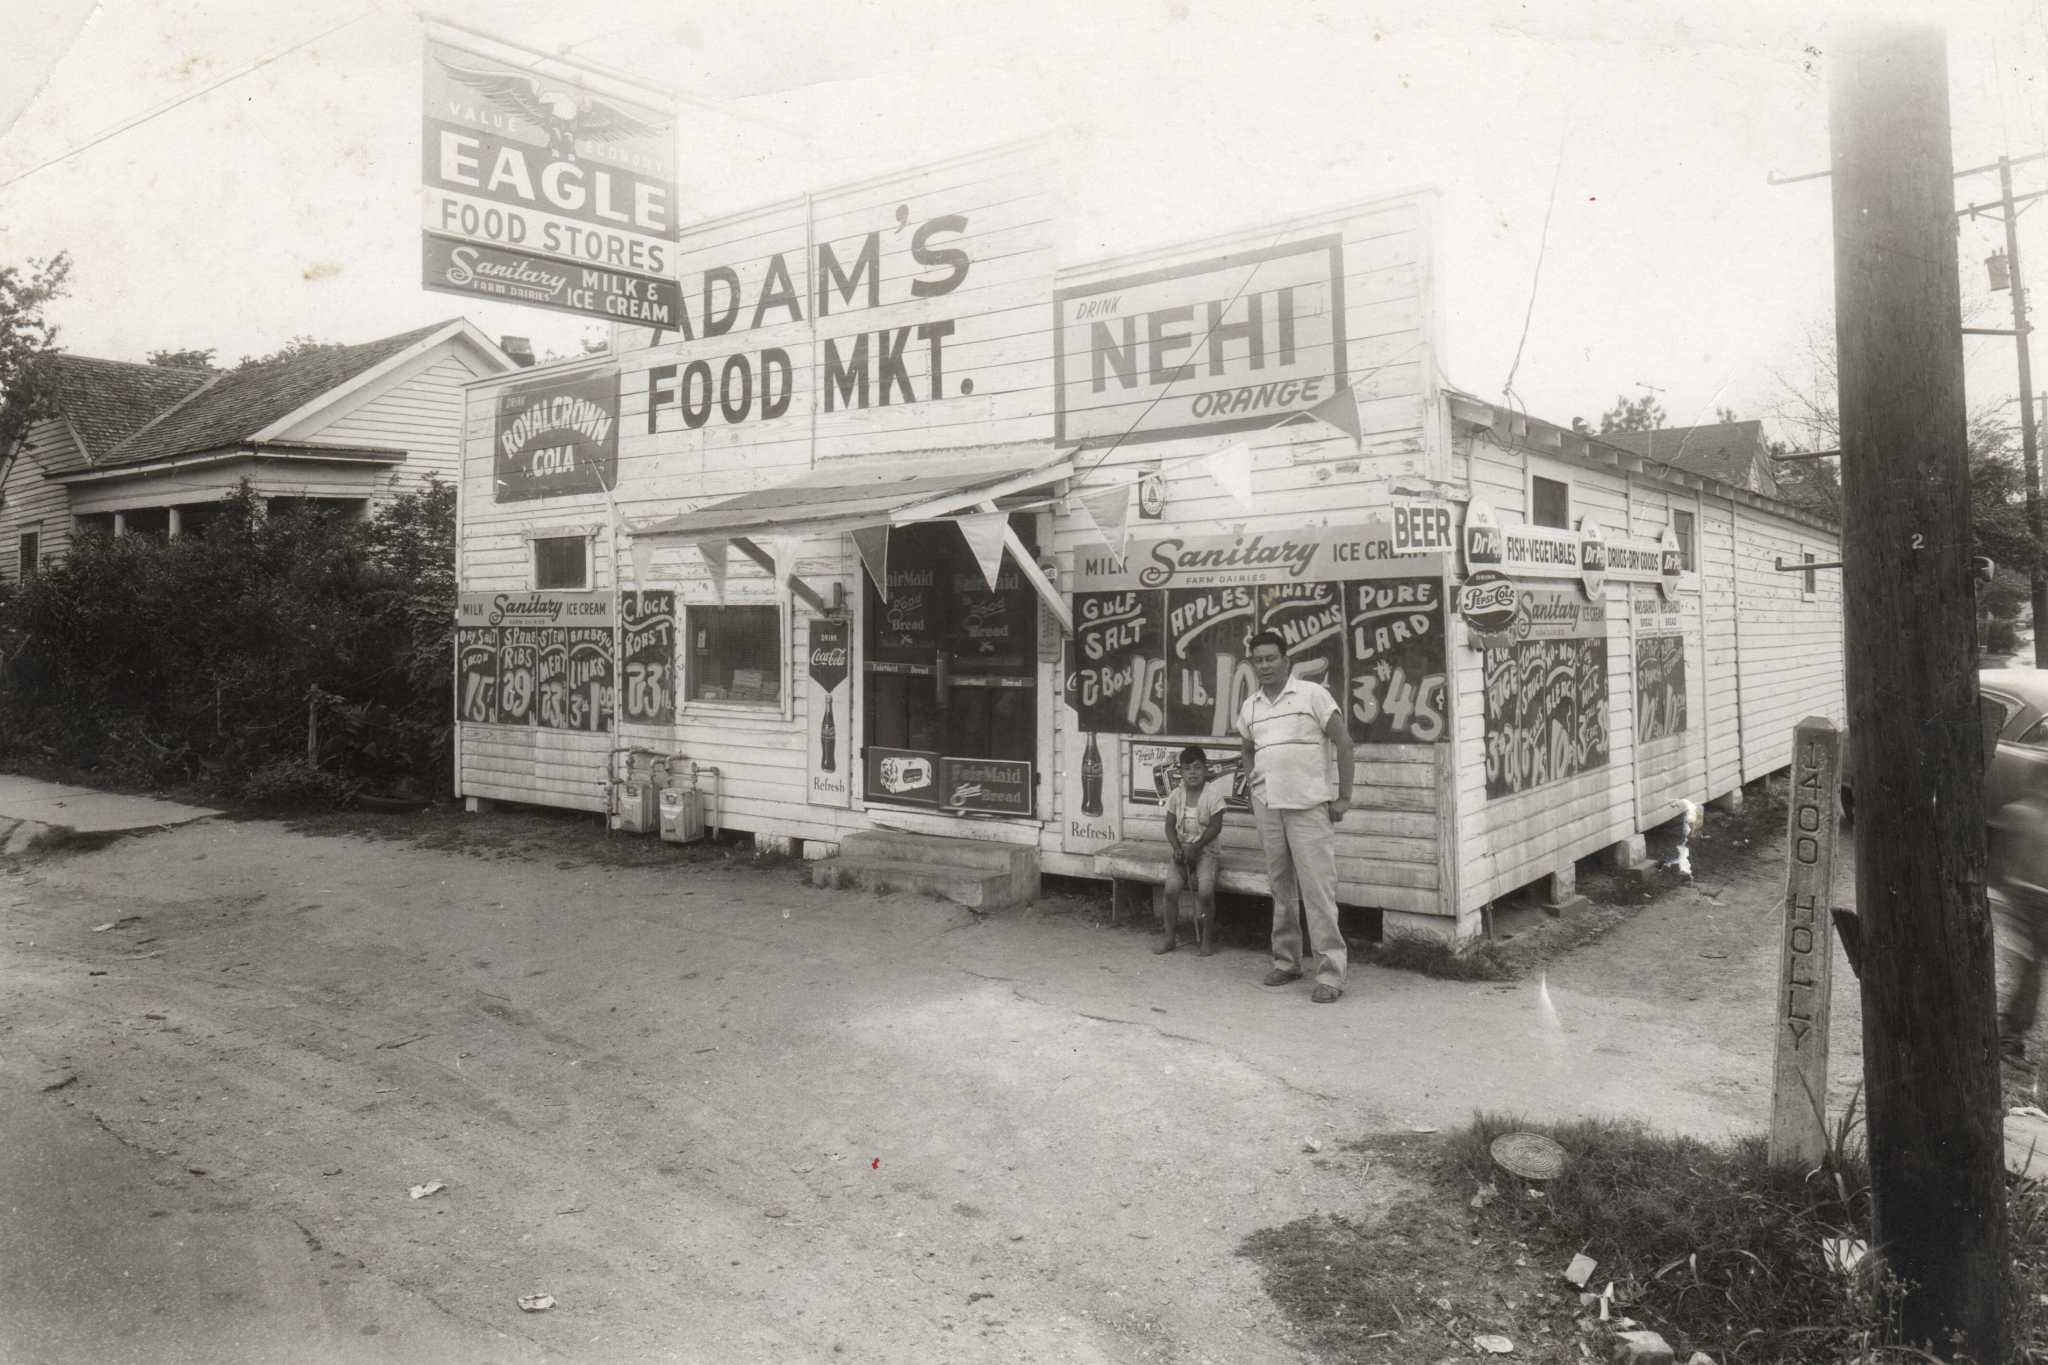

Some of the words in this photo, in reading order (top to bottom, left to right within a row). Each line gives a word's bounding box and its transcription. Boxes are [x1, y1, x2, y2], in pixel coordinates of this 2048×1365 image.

[450, 102, 518, 132] VALUE
[440, 130, 666, 232] EAGLE
[442, 198, 527, 244] FOOD
[543, 222, 664, 274] STORES
[446, 246, 567, 295] Sanitary
[582, 269, 637, 298] MILK
[647, 283, 658, 301] &
[473, 281, 505, 294] FARM
[510, 287, 552, 303] DAIRIES
[568, 289, 594, 311] ICE
[606, 295, 668, 323] CREAM
[1076, 296, 1122, 320] DRINK
[1090, 287, 1296, 393] NEHI
[648, 346, 793, 434] FOOD
[824, 318, 974, 413] MKT.
[1191, 375, 1328, 418] ORANGE
[502, 399, 553, 460] ROYAL
[552, 396, 612, 448] CROWN
[532, 445, 575, 477] COLA
[1394, 507, 1452, 549] BEER
[1911, 533, 1925, 550] 2
[1138, 536, 1320, 588] Sanitary
[1333, 541, 1360, 562] ICE
[1640, 550, 1659, 571] GOODS
[1186, 575, 1214, 585] FARM
[1219, 573, 1267, 583] DAIRIES
[1262, 583, 1328, 607] WHITE
[463, 603, 484, 617] MILK
[567, 603, 577, 616] ICE
[578, 602, 606, 616] CREAM
[488, 594, 563, 626] Sanitary
[1083, 593, 1137, 620] GULF
[1170, 587, 1249, 638] APPLES
[1358, 584, 1433, 611] PURE
[1266, 604, 1342, 646] NIONS
[1517, 592, 1580, 639] Sanitary
[460, 630, 475, 645] DRY
[478, 628, 497, 645] SALT
[504, 627, 536, 646] SPARE
[539, 629, 565, 646] STEW
[625, 622, 670, 657] ROAST
[1084, 618, 1147, 660] SALT
[1355, 614, 1430, 660] LARD
[463, 653, 489, 672] BACON
[504, 648, 533, 669] RIBS
[540, 652, 567, 682] MEAT
[811, 647, 847, 666] Coca-Cola
[570, 657, 605, 690] LINKS
[1102, 664, 1133, 698] Box
[1181, 668, 1215, 707] lb.
[1489, 667, 1518, 720] RICE
[1546, 680, 1576, 715] BLEACH
[814, 776, 845, 793] Refresh
[1798, 740, 1822, 866] 1400
[1072, 821, 1116, 840] Refresh
[1786, 893, 1817, 1052] HOLLY
